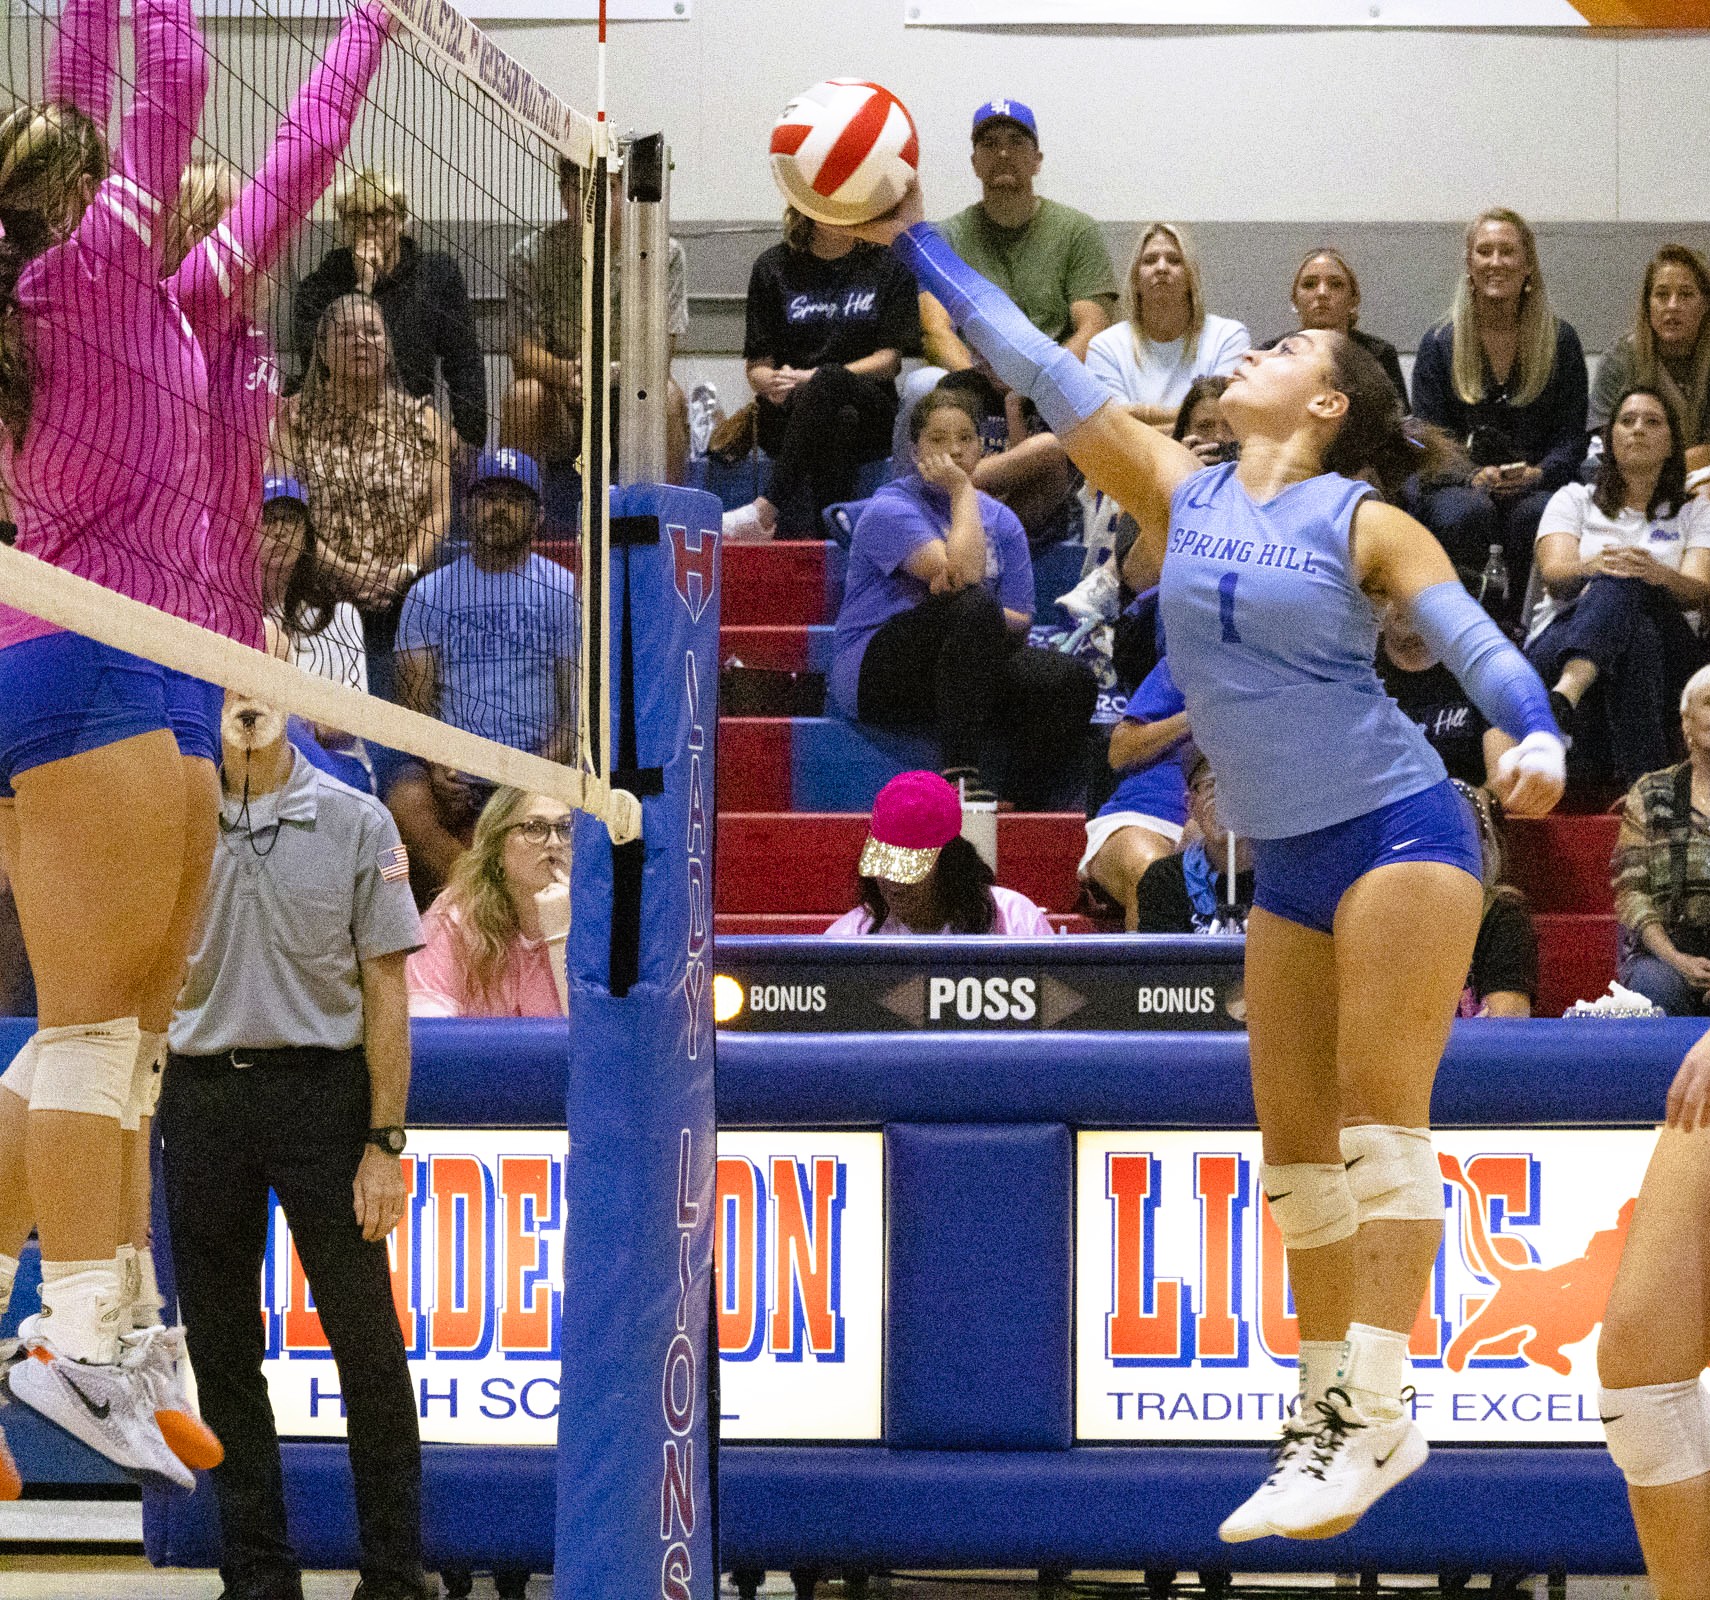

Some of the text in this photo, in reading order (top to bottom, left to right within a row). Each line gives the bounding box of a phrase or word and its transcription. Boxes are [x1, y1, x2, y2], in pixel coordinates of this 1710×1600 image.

[842, 292, 876, 317] Hill
[1170, 527, 1317, 575] SPRING HILL
[1217, 571, 1243, 644] 1
[685, 650, 707, 1061] LADY
[749, 985, 827, 1012] BONUS
[930, 977, 1037, 1021] POSS
[1138, 986, 1215, 1013] BONUS
[1106, 1392, 1305, 1421] TRADITI
[1452, 1393, 1601, 1422] EXCEL
